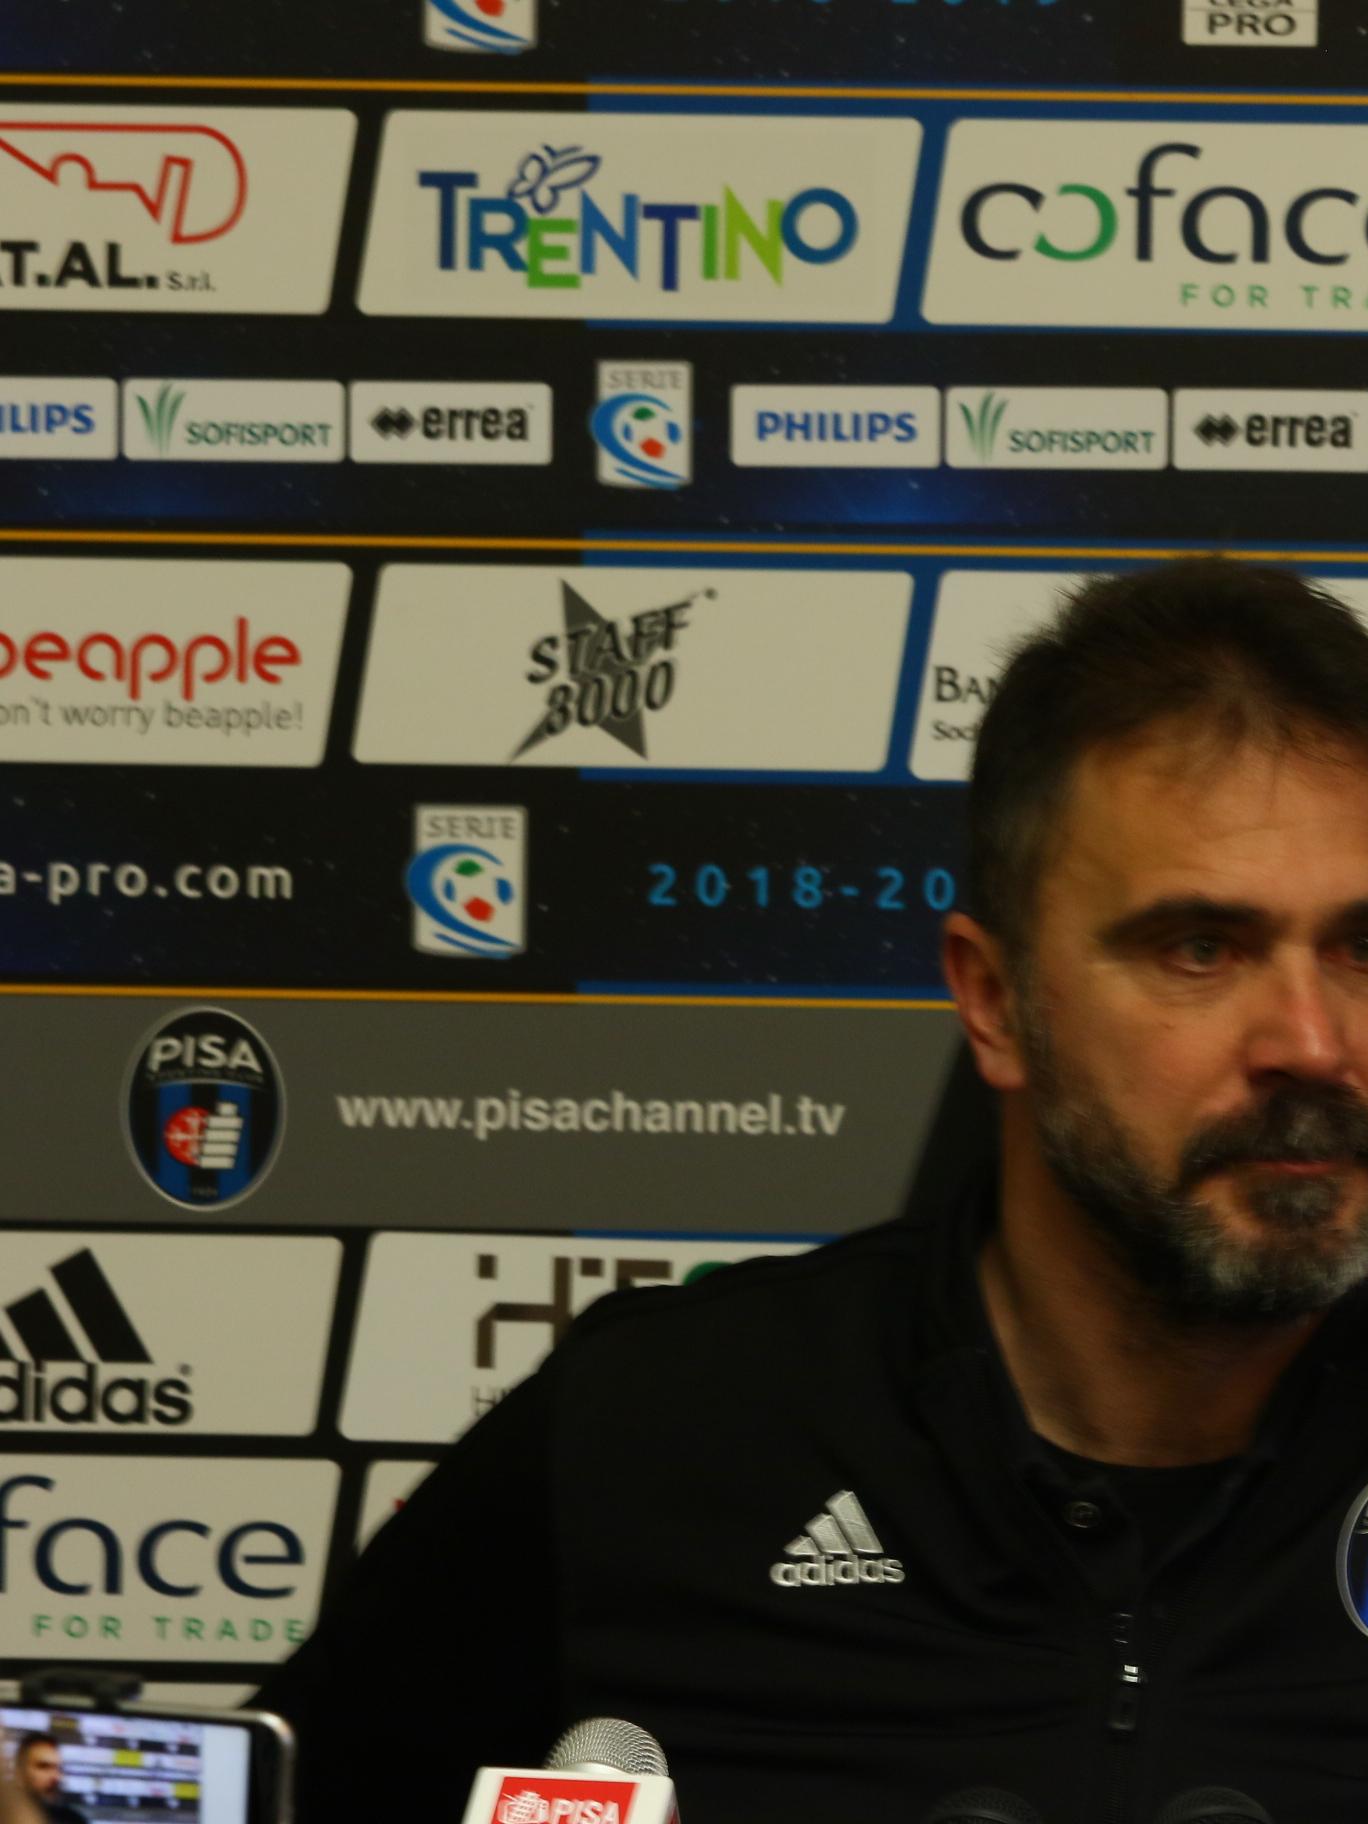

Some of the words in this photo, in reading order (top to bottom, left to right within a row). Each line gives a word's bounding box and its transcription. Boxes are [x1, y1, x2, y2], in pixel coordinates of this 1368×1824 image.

[1207, 13, 1297, 36] PRO
[418, 170, 859, 292] TRENTINO
[0, 240, 159, 289] T.AL.
[1181, 284, 1268, 307] FOR
[607, 369, 683, 390] SERIE
[186, 420, 332, 446] SOFISPORT
[422, 405, 528, 442] errea
[755, 411, 917, 442] PHILIPS
[1244, 412, 1352, 448] errea
[1009, 429, 1154, 454] SOFISPORT
[525, 601, 692, 685] STAFF
[544, 660, 673, 737] 3000
[60, 704, 153, 736] worry
[164, 702, 304, 738] beapple!
[425, 815, 517, 839] SERIE
[147, 1034, 263, 1074] PISA
[337, 1089, 845, 1140] www.pisachannel.tv
[769, 1553, 906, 1587] adidas
[33, 1614, 121, 1639] FOR
[155, 1616, 304, 1643] TRADE
[551, 1797, 621, 1824] PISA
